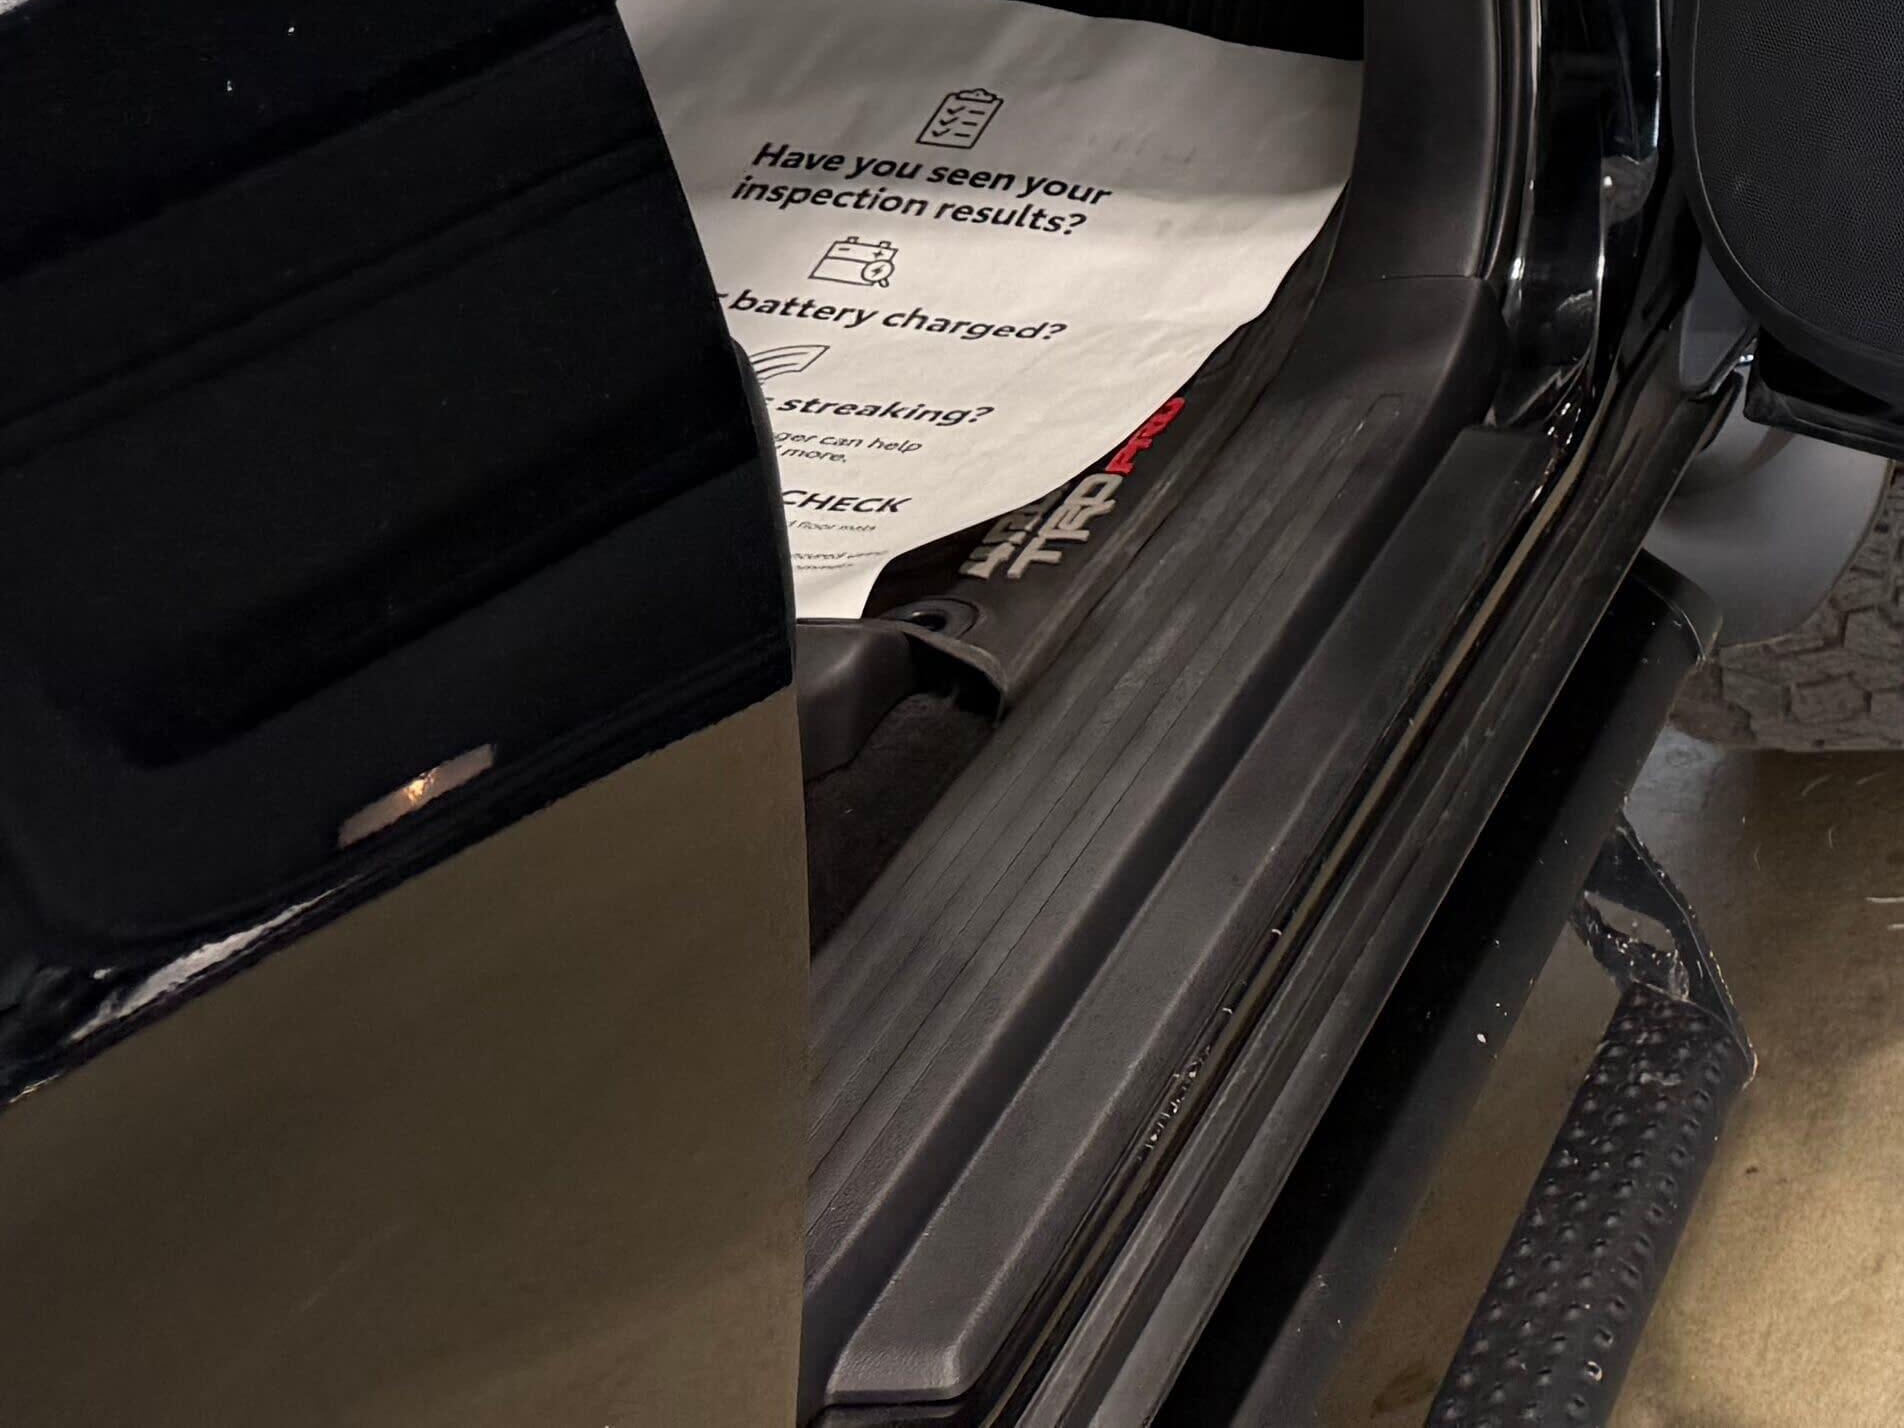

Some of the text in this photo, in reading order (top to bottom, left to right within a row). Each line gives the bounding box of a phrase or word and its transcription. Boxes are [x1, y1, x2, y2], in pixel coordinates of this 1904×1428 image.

[752, 142, 1112, 206] Have you seen your
[734, 176, 1087, 236] inspection results?
[728, 289, 1068, 341] battery charged?
[776, 396, 998, 427] streaking?
[780, 448, 847, 463] more.
[819, 436, 864, 448] can
[867, 437, 923, 453] help
[781, 489, 913, 513] CHECK
[1007, 472, 1124, 579] TRD
[1105, 397, 1186, 477] PRO
